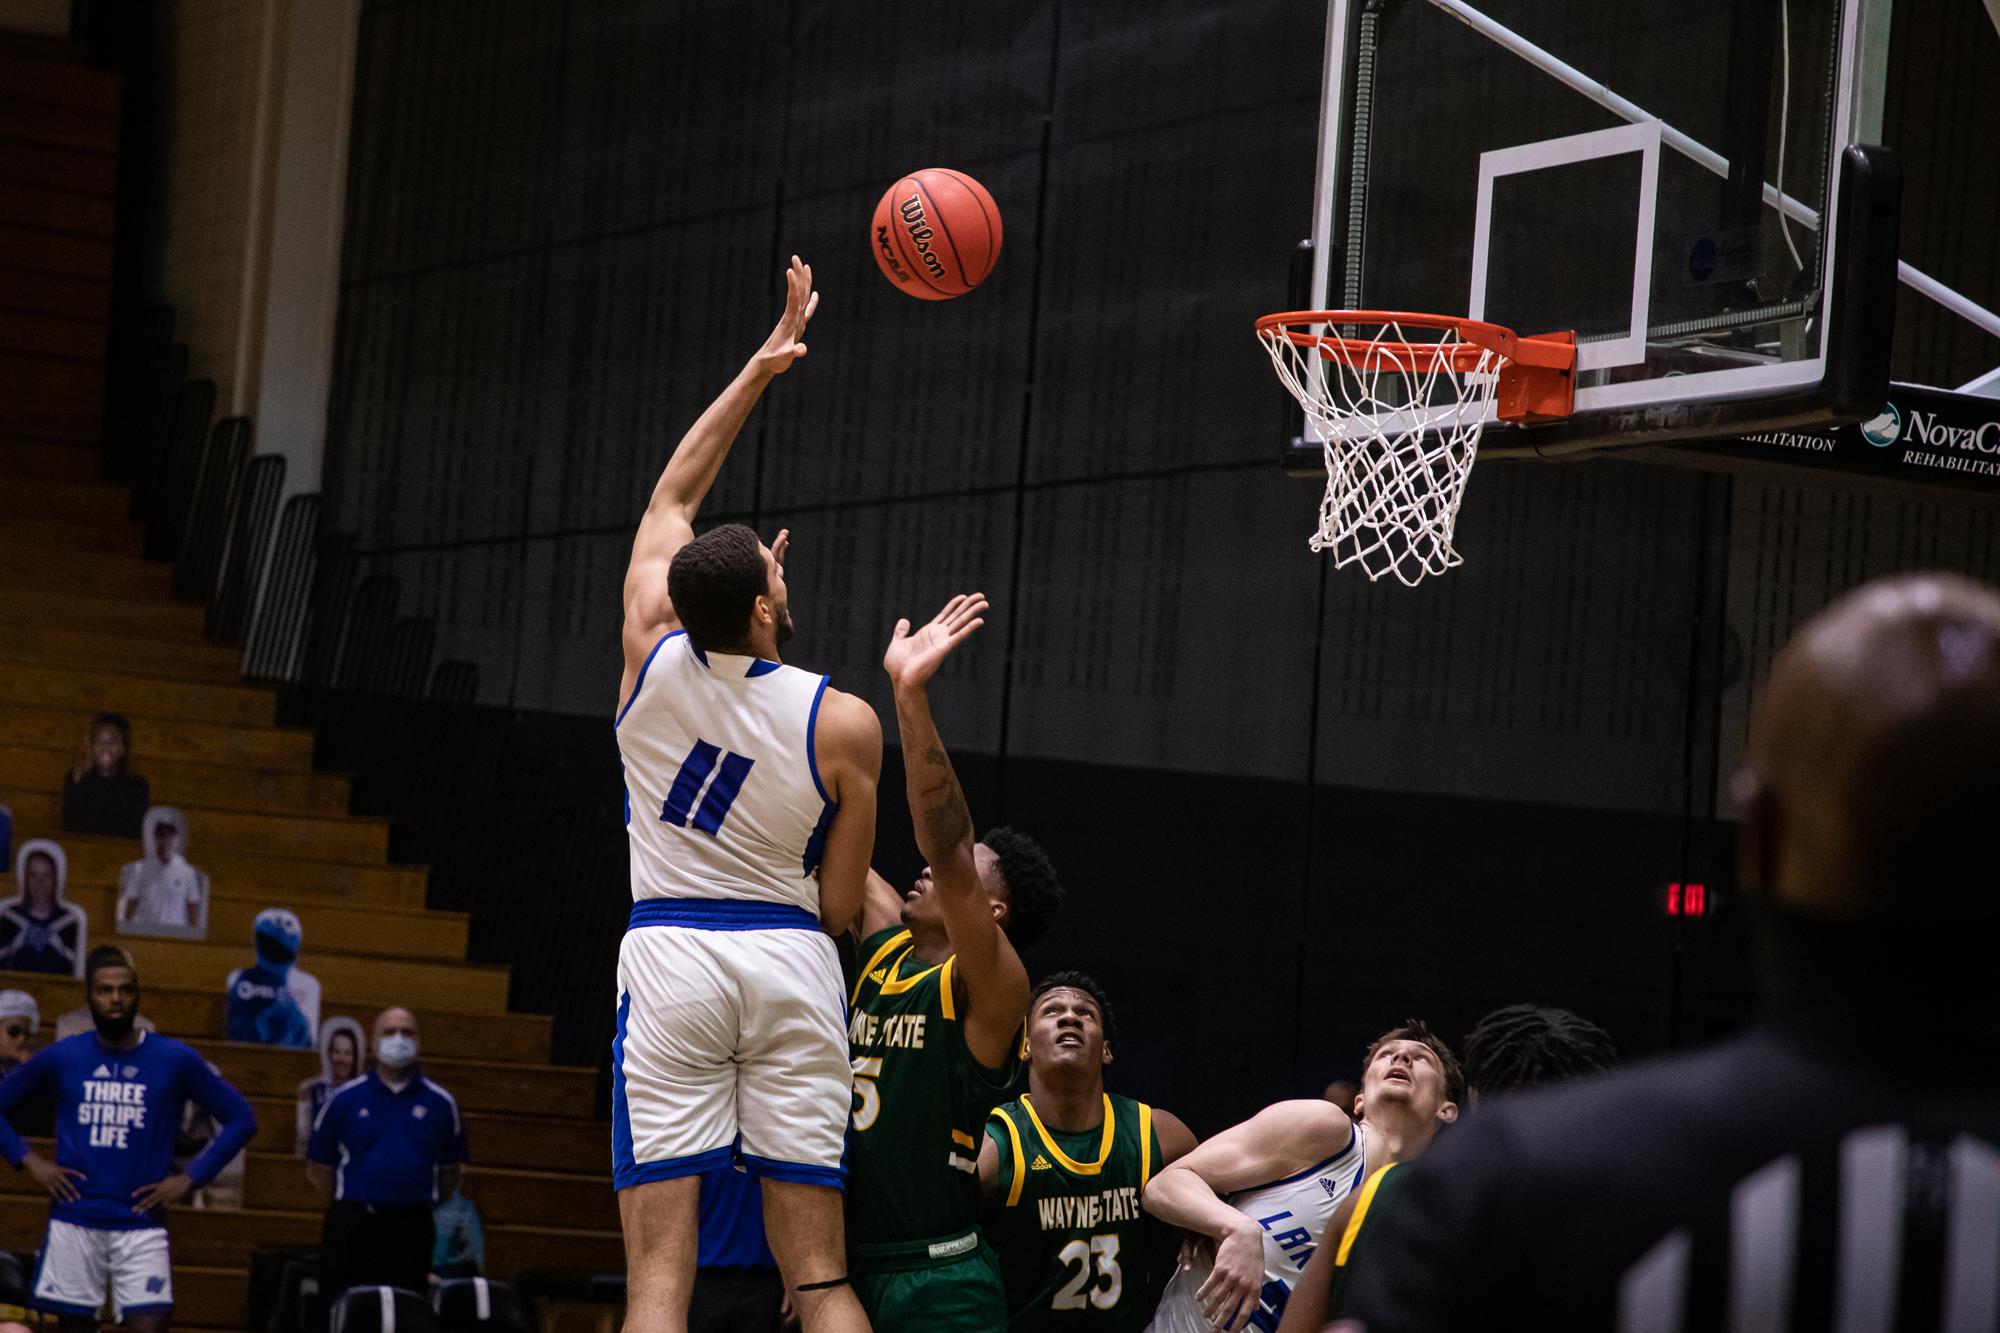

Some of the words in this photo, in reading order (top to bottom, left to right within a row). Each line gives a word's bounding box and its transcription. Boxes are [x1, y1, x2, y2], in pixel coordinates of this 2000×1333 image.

[877, 225, 911, 283] NCAA
[900, 193, 946, 280] Wilson
[1740, 432, 1836, 453] ILITATION
[1902, 410, 2000, 455] NovaC
[659, 737, 755, 837] 11
[82, 1080, 147, 1105] THREE
[78, 1102, 147, 1129] STRIPE
[88, 1124, 130, 1149] LIFE
[1037, 1195, 1099, 1231] WAYNE
[1051, 1233, 1122, 1310] 23
